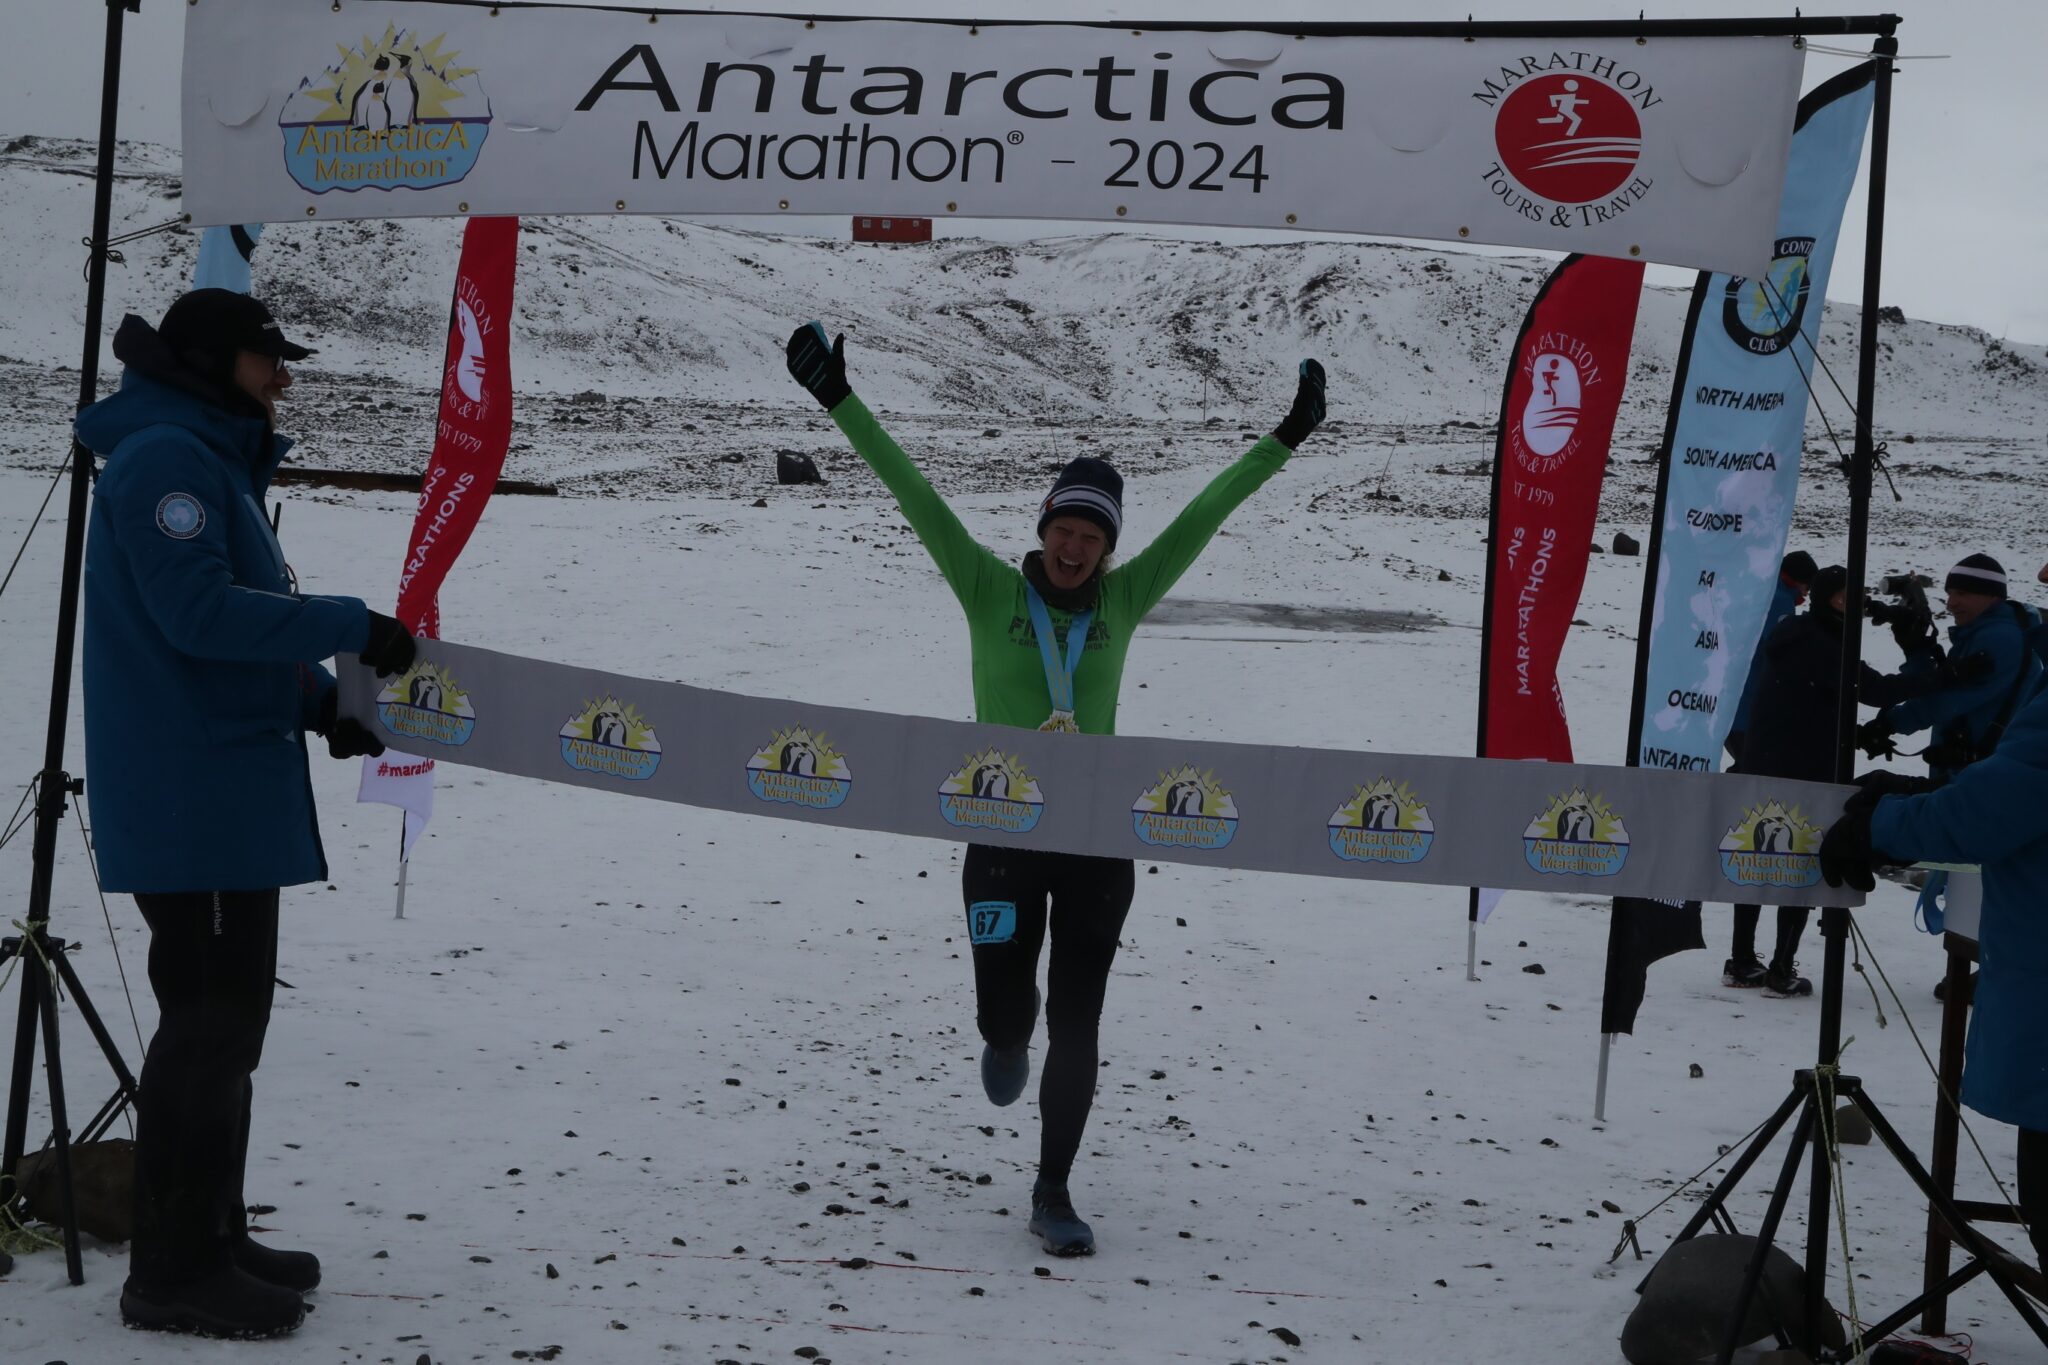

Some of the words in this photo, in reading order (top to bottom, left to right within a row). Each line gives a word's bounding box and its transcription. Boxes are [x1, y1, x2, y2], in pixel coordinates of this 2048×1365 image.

[574, 44, 1345, 131] Antarctica
[1472, 51, 1664, 110] MARATHON
[1104, 138, 1269, 193] 2024
[1481, 162, 1544, 222] TOURS
[1549, 205, 1571, 228] &
[1575, 177, 1653, 227] TRAVEL
[458, 402, 472, 418] &
[452, 430, 482, 454] 1979
[1527, 456, 1541, 473] &
[1528, 486, 1555, 507] 1979
[1695, 630, 1719, 650] ASIA
[976, 910, 1001, 936] 67
